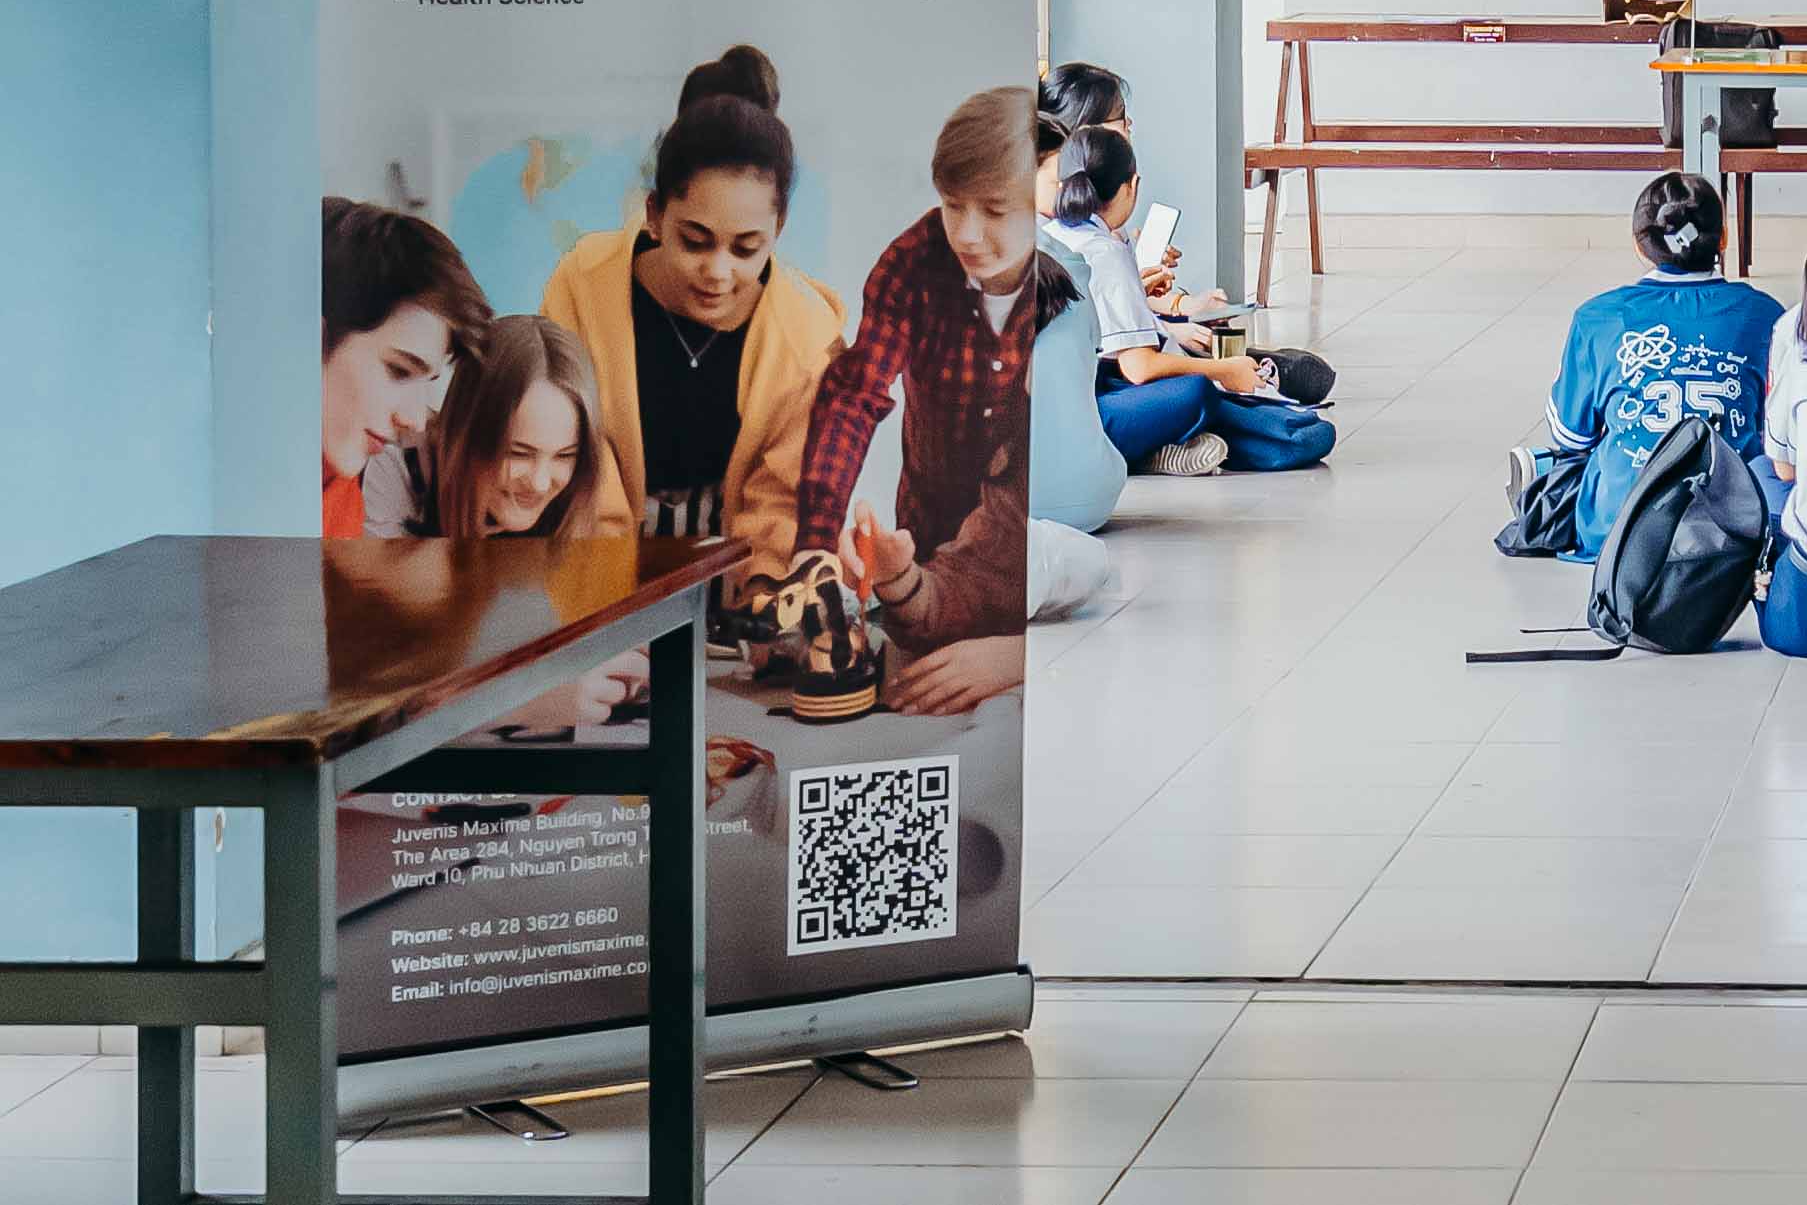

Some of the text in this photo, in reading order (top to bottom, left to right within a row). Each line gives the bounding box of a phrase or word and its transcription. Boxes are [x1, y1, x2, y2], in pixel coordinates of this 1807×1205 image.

[1642, 379, 1726, 433] 35
[392, 822, 458, 844] Juvenis
[463, 817, 531, 838] Maxime
[536, 810, 607, 832] Building,
[392, 848, 424, 866] The
[430, 845, 470, 863] Area
[520, 834, 585, 858] Nguyen
[591, 828, 637, 849] Trong
[392, 869, 436, 888] Ward
[443, 866, 467, 886] 10,
[472, 861, 505, 880] Phu
[510, 858, 566, 878] Nhuan
[571, 852, 635, 873] District,
[392, 926, 453, 946] Phone:
[458, 921, 492, 938] +84
[498, 917, 520, 934] 28
[526, 912, 570, 932] 3622
[392, 932, 648, 974] Website: www.juvenismaxime.
[392, 960, 650, 1002] Email: info@juvenismaxime.co
